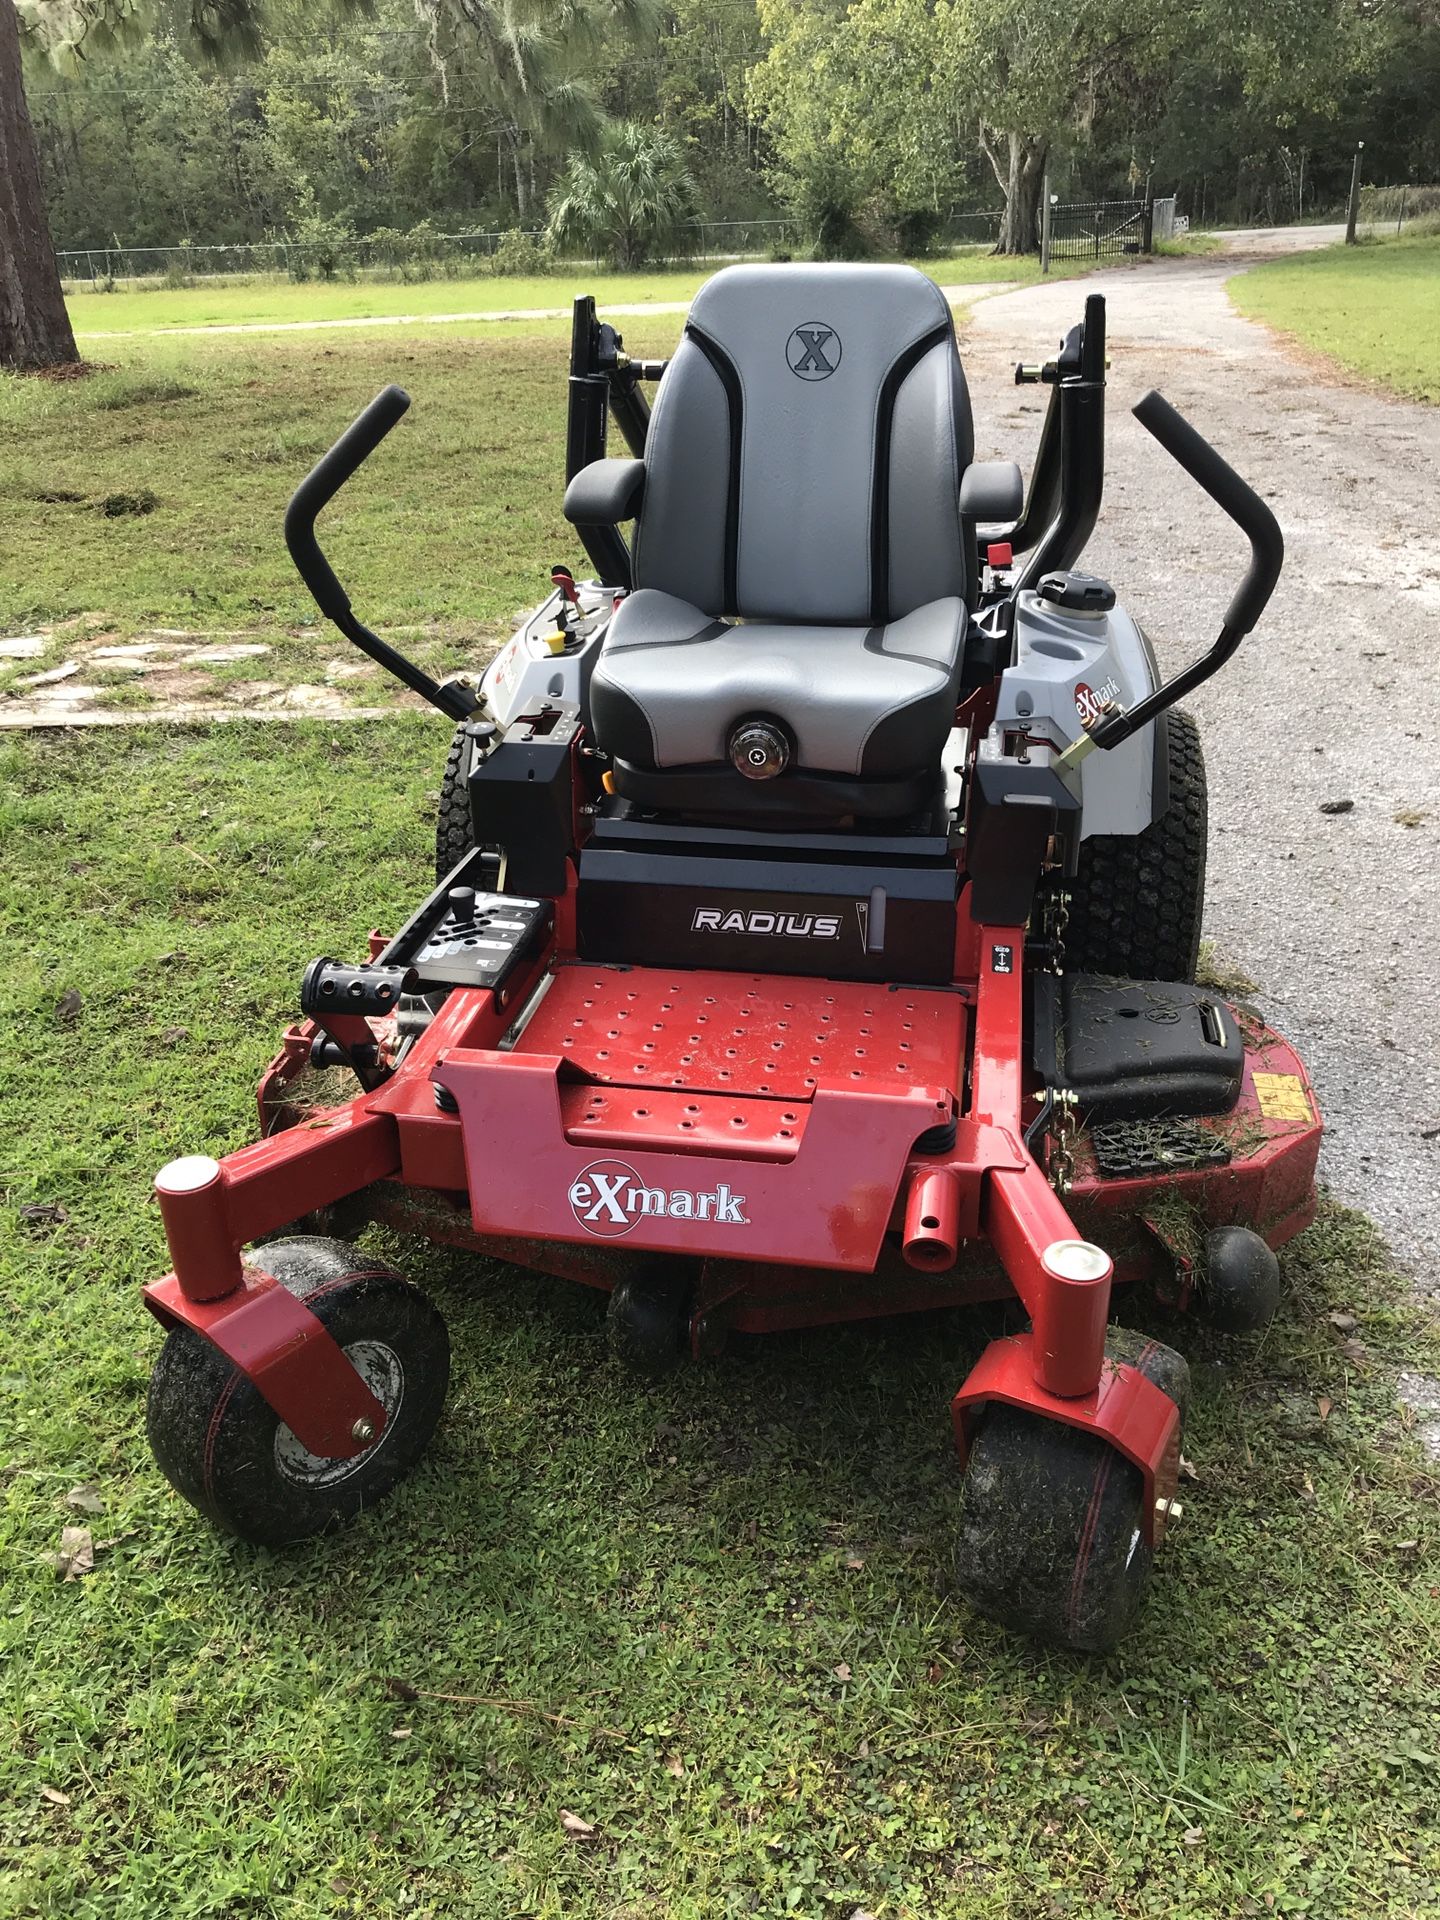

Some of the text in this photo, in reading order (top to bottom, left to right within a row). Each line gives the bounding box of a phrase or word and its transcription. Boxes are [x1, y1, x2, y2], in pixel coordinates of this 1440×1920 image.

[793, 328, 835, 373] X
[1075, 676, 1121, 718] eXmark
[694, 909, 841, 937] RADIUS
[568, 1172, 747, 1225] eXmark
